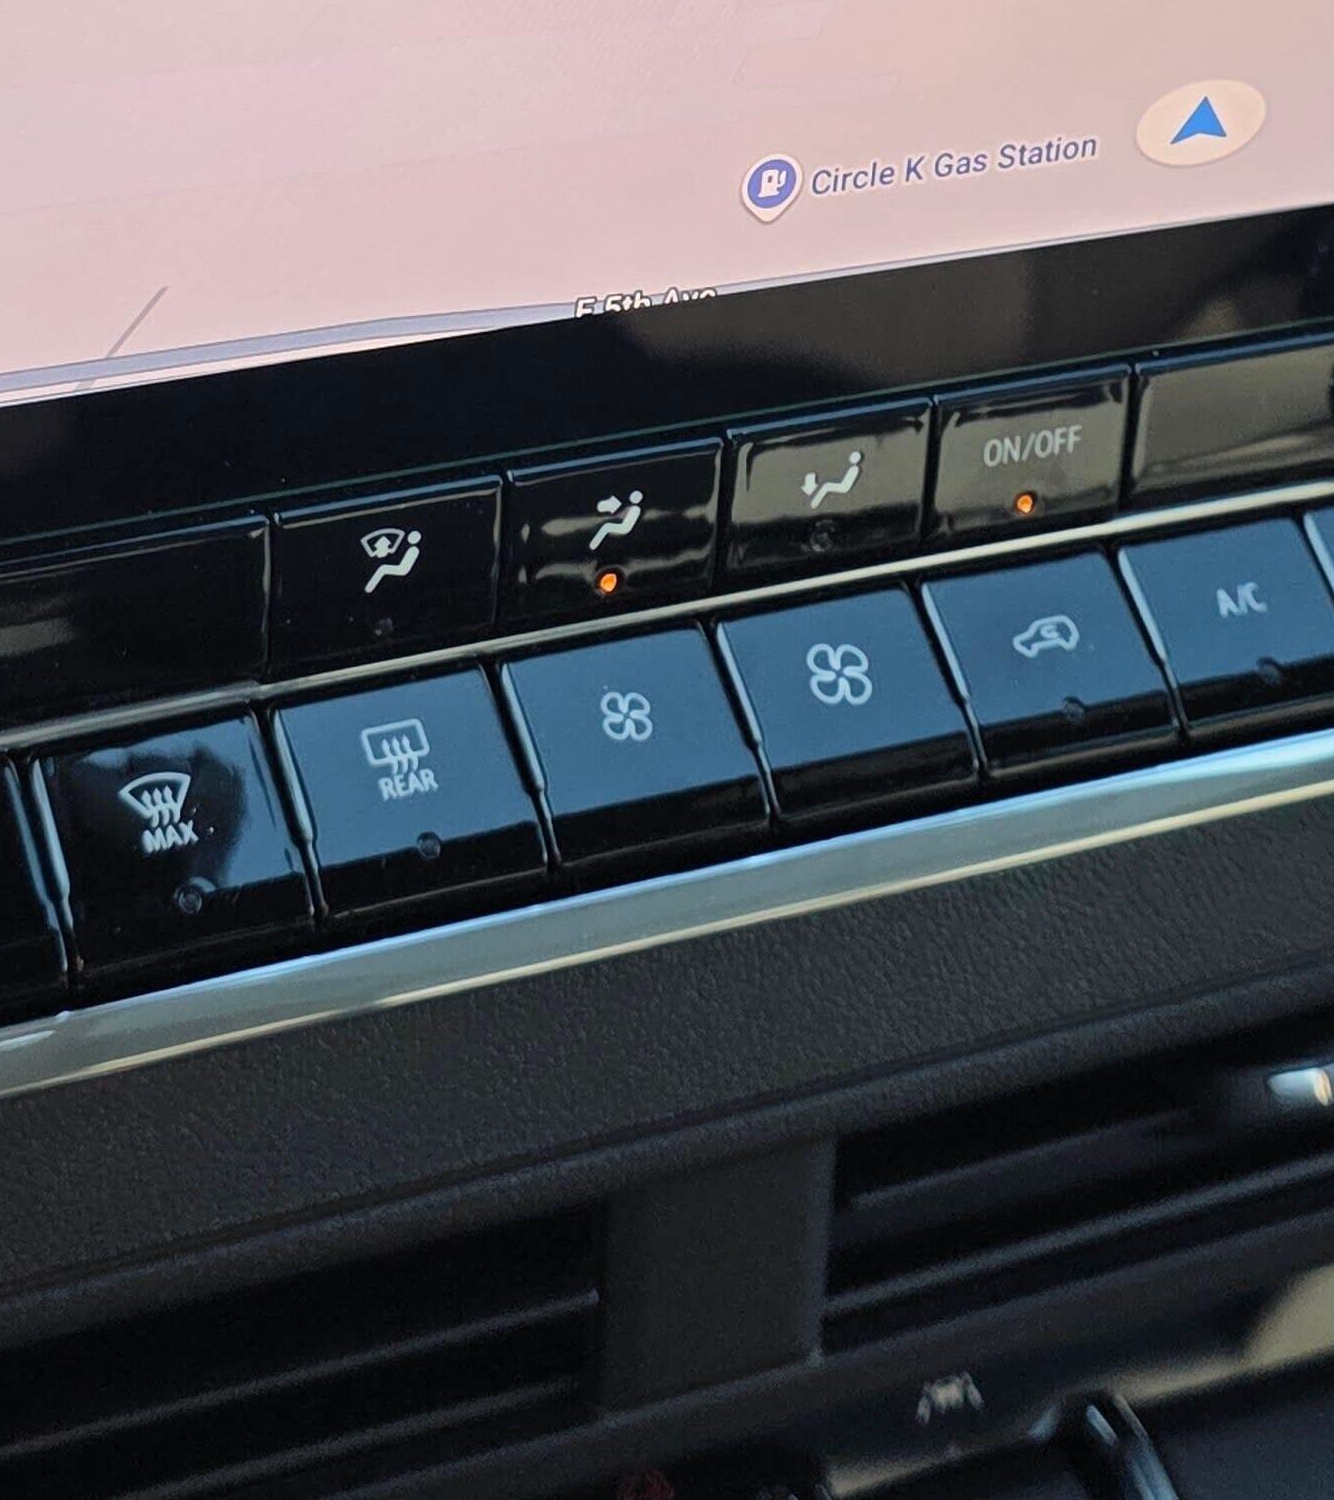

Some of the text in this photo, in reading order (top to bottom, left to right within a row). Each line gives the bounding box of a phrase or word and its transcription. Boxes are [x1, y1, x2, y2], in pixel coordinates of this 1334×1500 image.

[811, 135, 1099, 196] Circle K Gas Station
[982, 423, 1083, 470] ON/OFF
[1215, 579, 1267, 620] A/C
[377, 768, 439, 801] REAR
[142, 819, 200, 855] MAX
